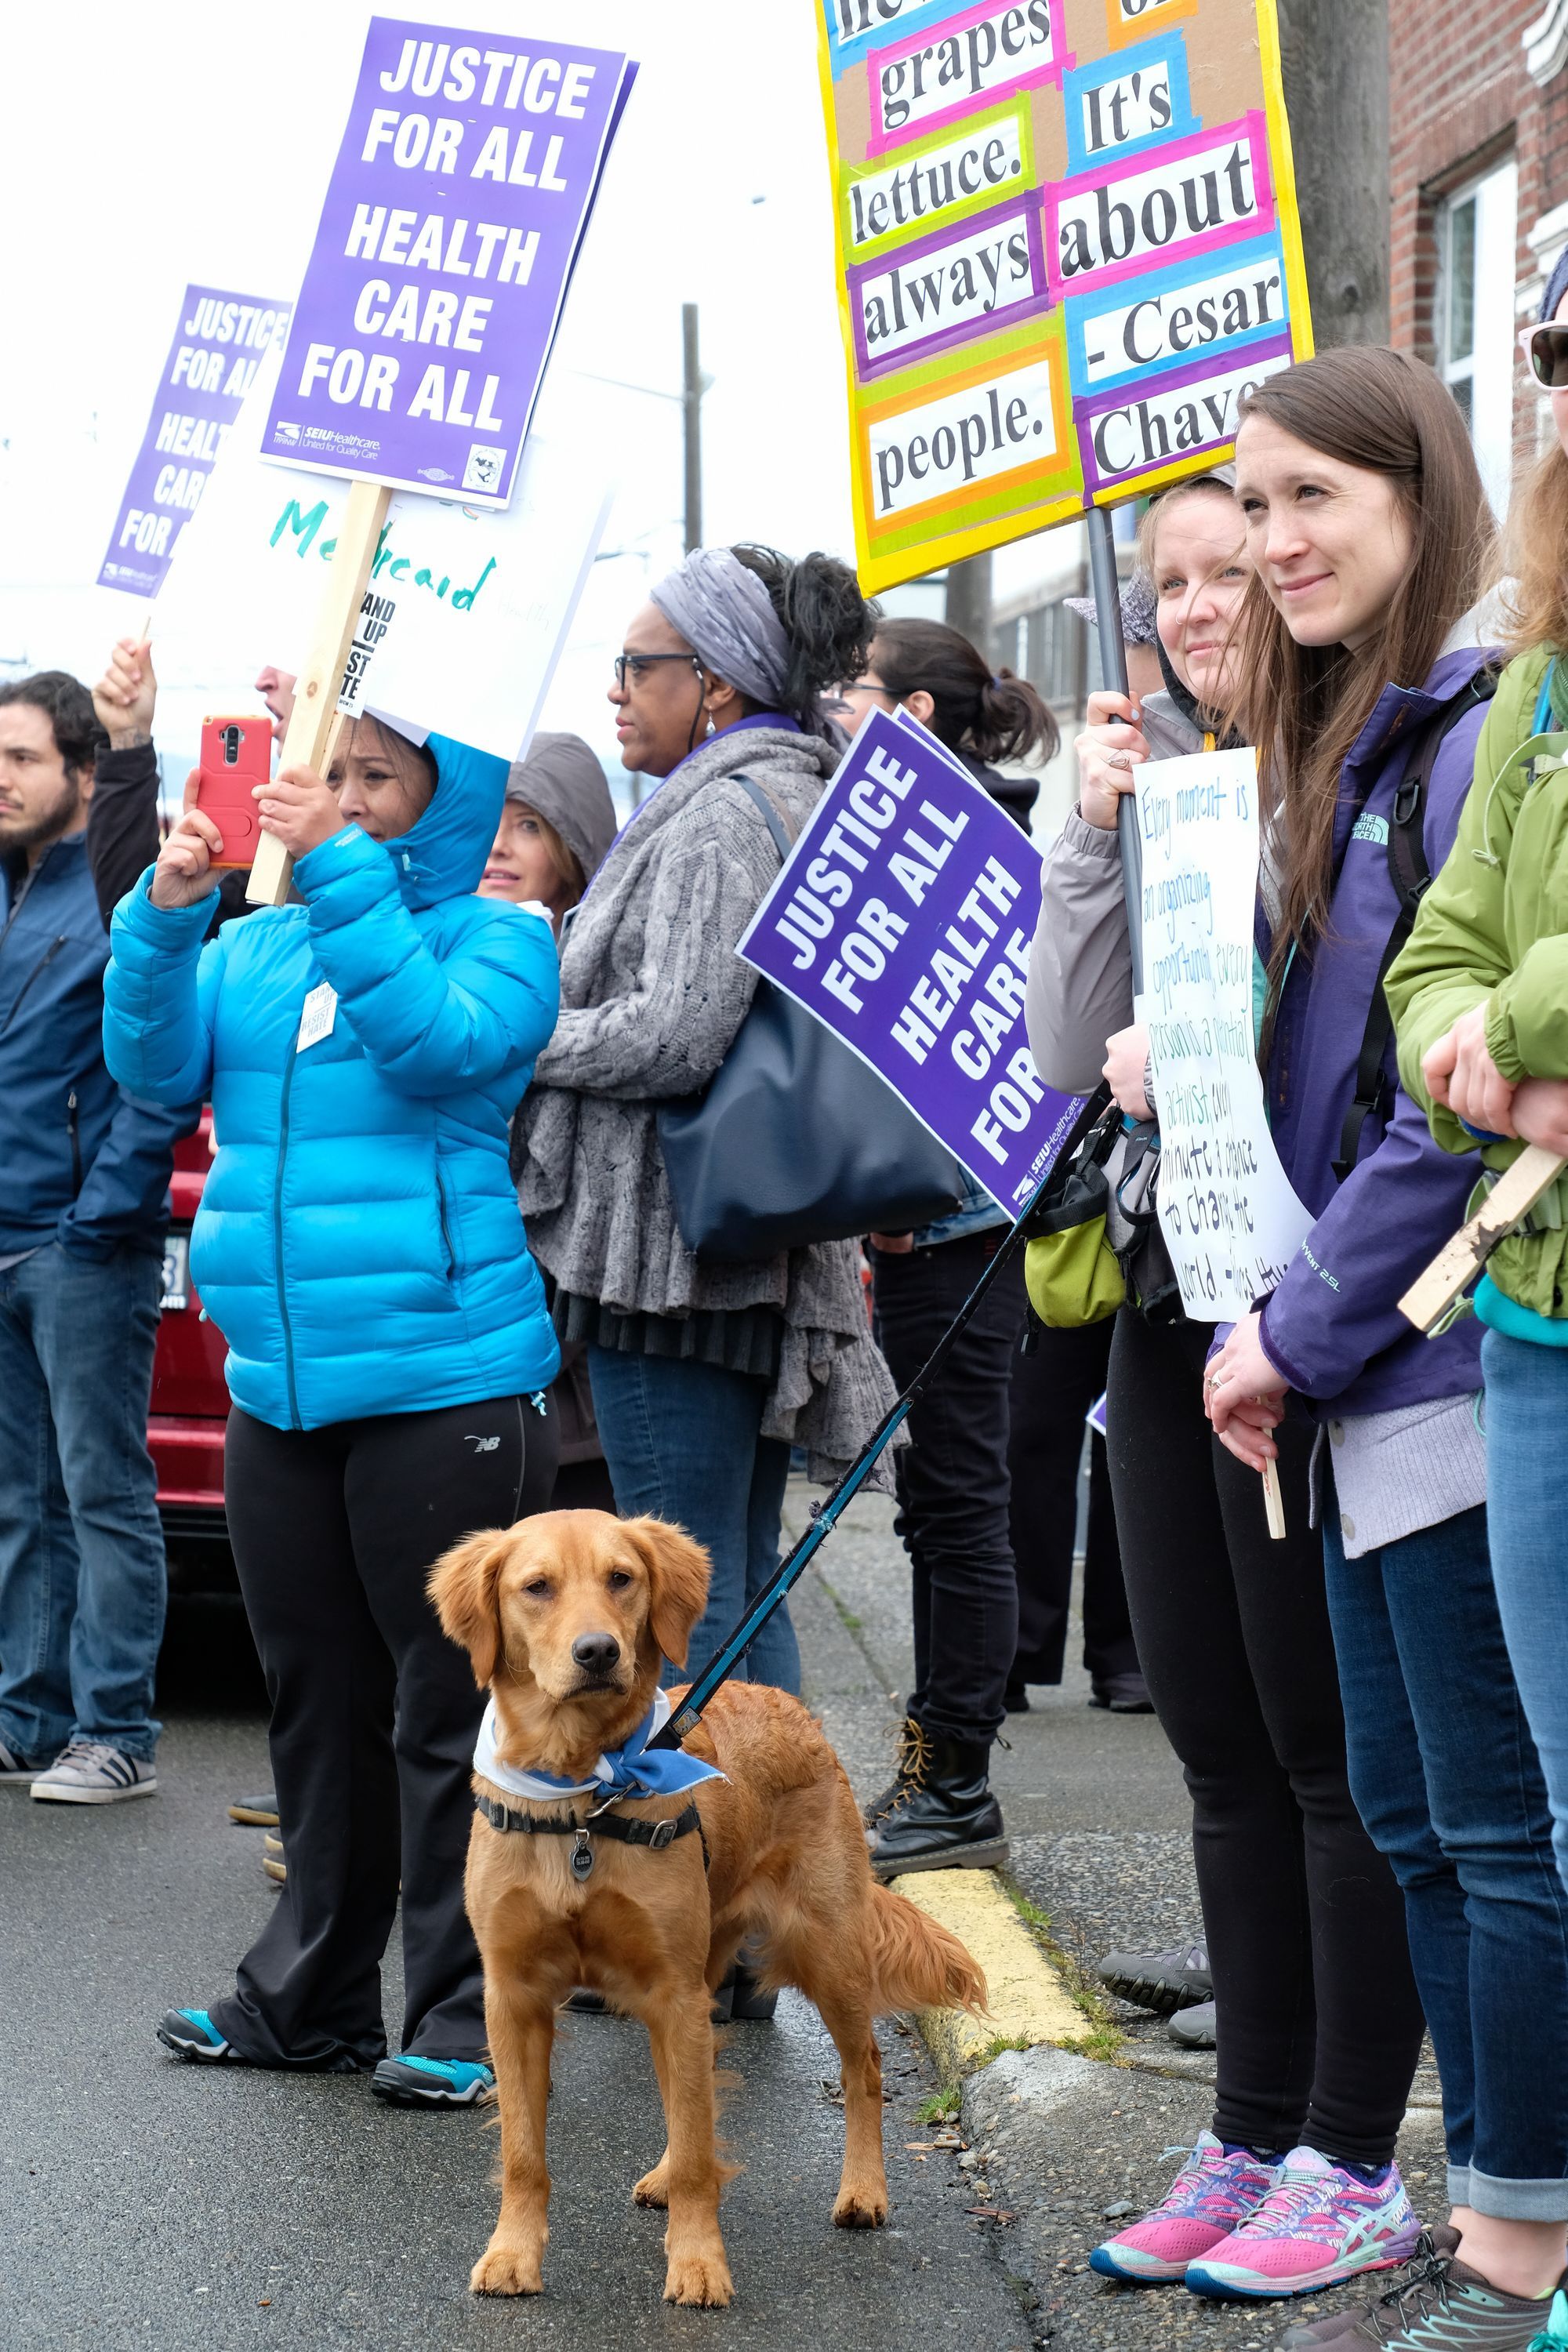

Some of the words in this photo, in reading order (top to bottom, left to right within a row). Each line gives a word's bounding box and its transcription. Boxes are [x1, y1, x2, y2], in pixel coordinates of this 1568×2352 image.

[379, 39, 597, 120] JUSTICE
[880, 0, 1051, 129] grapes
[361, 107, 465, 175] FOR
[470, 125, 568, 192] ALL
[1083, 72, 1172, 153] It's
[851, 137, 1022, 243] lettuce.
[1059, 142, 1254, 278] about
[343, 203, 541, 285] HEALTH
[184, 297, 289, 351] JUSTICE
[353, 278, 494, 353] CARE
[863, 230, 1030, 344] always
[1122, 274, 1280, 366] Cesar
[170, 345, 226, 393] FOR
[222, 357, 258, 398] AL
[298, 343, 401, 413] FOR
[406, 365, 503, 433] ALL
[153, 464, 209, 510] CAR
[303, 439, 325, 450] United
[325, 441, 336, 452] for
[336, 445, 361, 458] Quality
[361, 448, 378, 459] Care
[876, 389, 1043, 511] people.
[118, 509, 172, 557] FOR
[360, 591, 396, 623] AND
[363, 619, 387, 644] UP
[340, 673, 361, 699] TE
[775, 745, 918, 971] JUSTICE
[1142, 786, 1171, 861] Every
[1176, 776, 1227, 824] moment
[1236, 779, 1248, 821] is
[820, 897, 910, 1014] FOR
[887, 800, 970, 907] ALL
[1144, 886, 1155, 923] an
[1158, 865, 1212, 944] organizing
[890, 855, 1022, 1065] HEALTH
[950, 927, 1033, 1081] CARE
[1149, 1022, 1190, 1078] person
[1185, 1011, 1202, 1056] is
[1202, 1018, 1212, 1057] a
[970, 1047, 1045, 1166] FOR
[1162, 1134, 1213, 1187] minute
[1215, 1138, 1222, 1178] a
[1165, 1196, 1181, 1236] to
[1233, 1185, 1254, 1236] the
[1319, 1268, 1341, 1293] 2.5L
